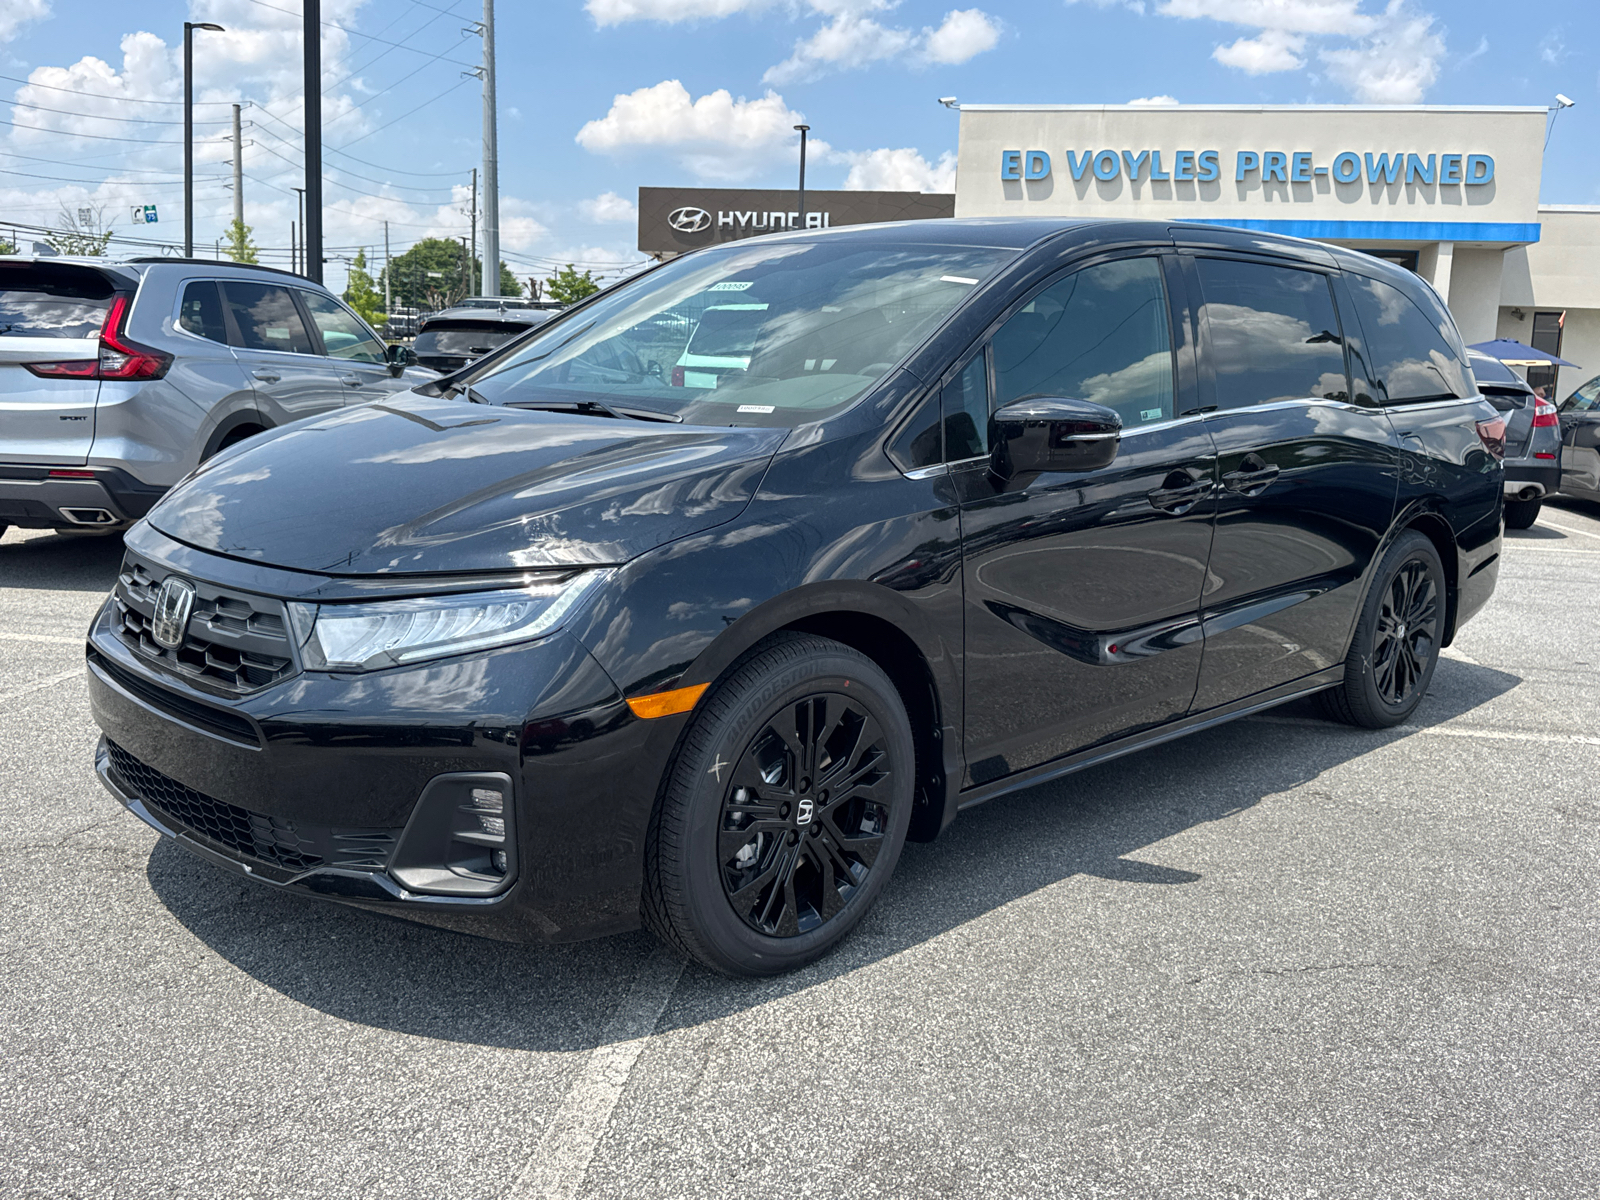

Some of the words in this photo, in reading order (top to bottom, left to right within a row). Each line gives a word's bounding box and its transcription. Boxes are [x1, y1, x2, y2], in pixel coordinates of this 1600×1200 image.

[1001, 150, 1051, 181] ED
[1066, 150, 1219, 182] VOYLES
[1235, 151, 1496, 185] PRE-OWNED
